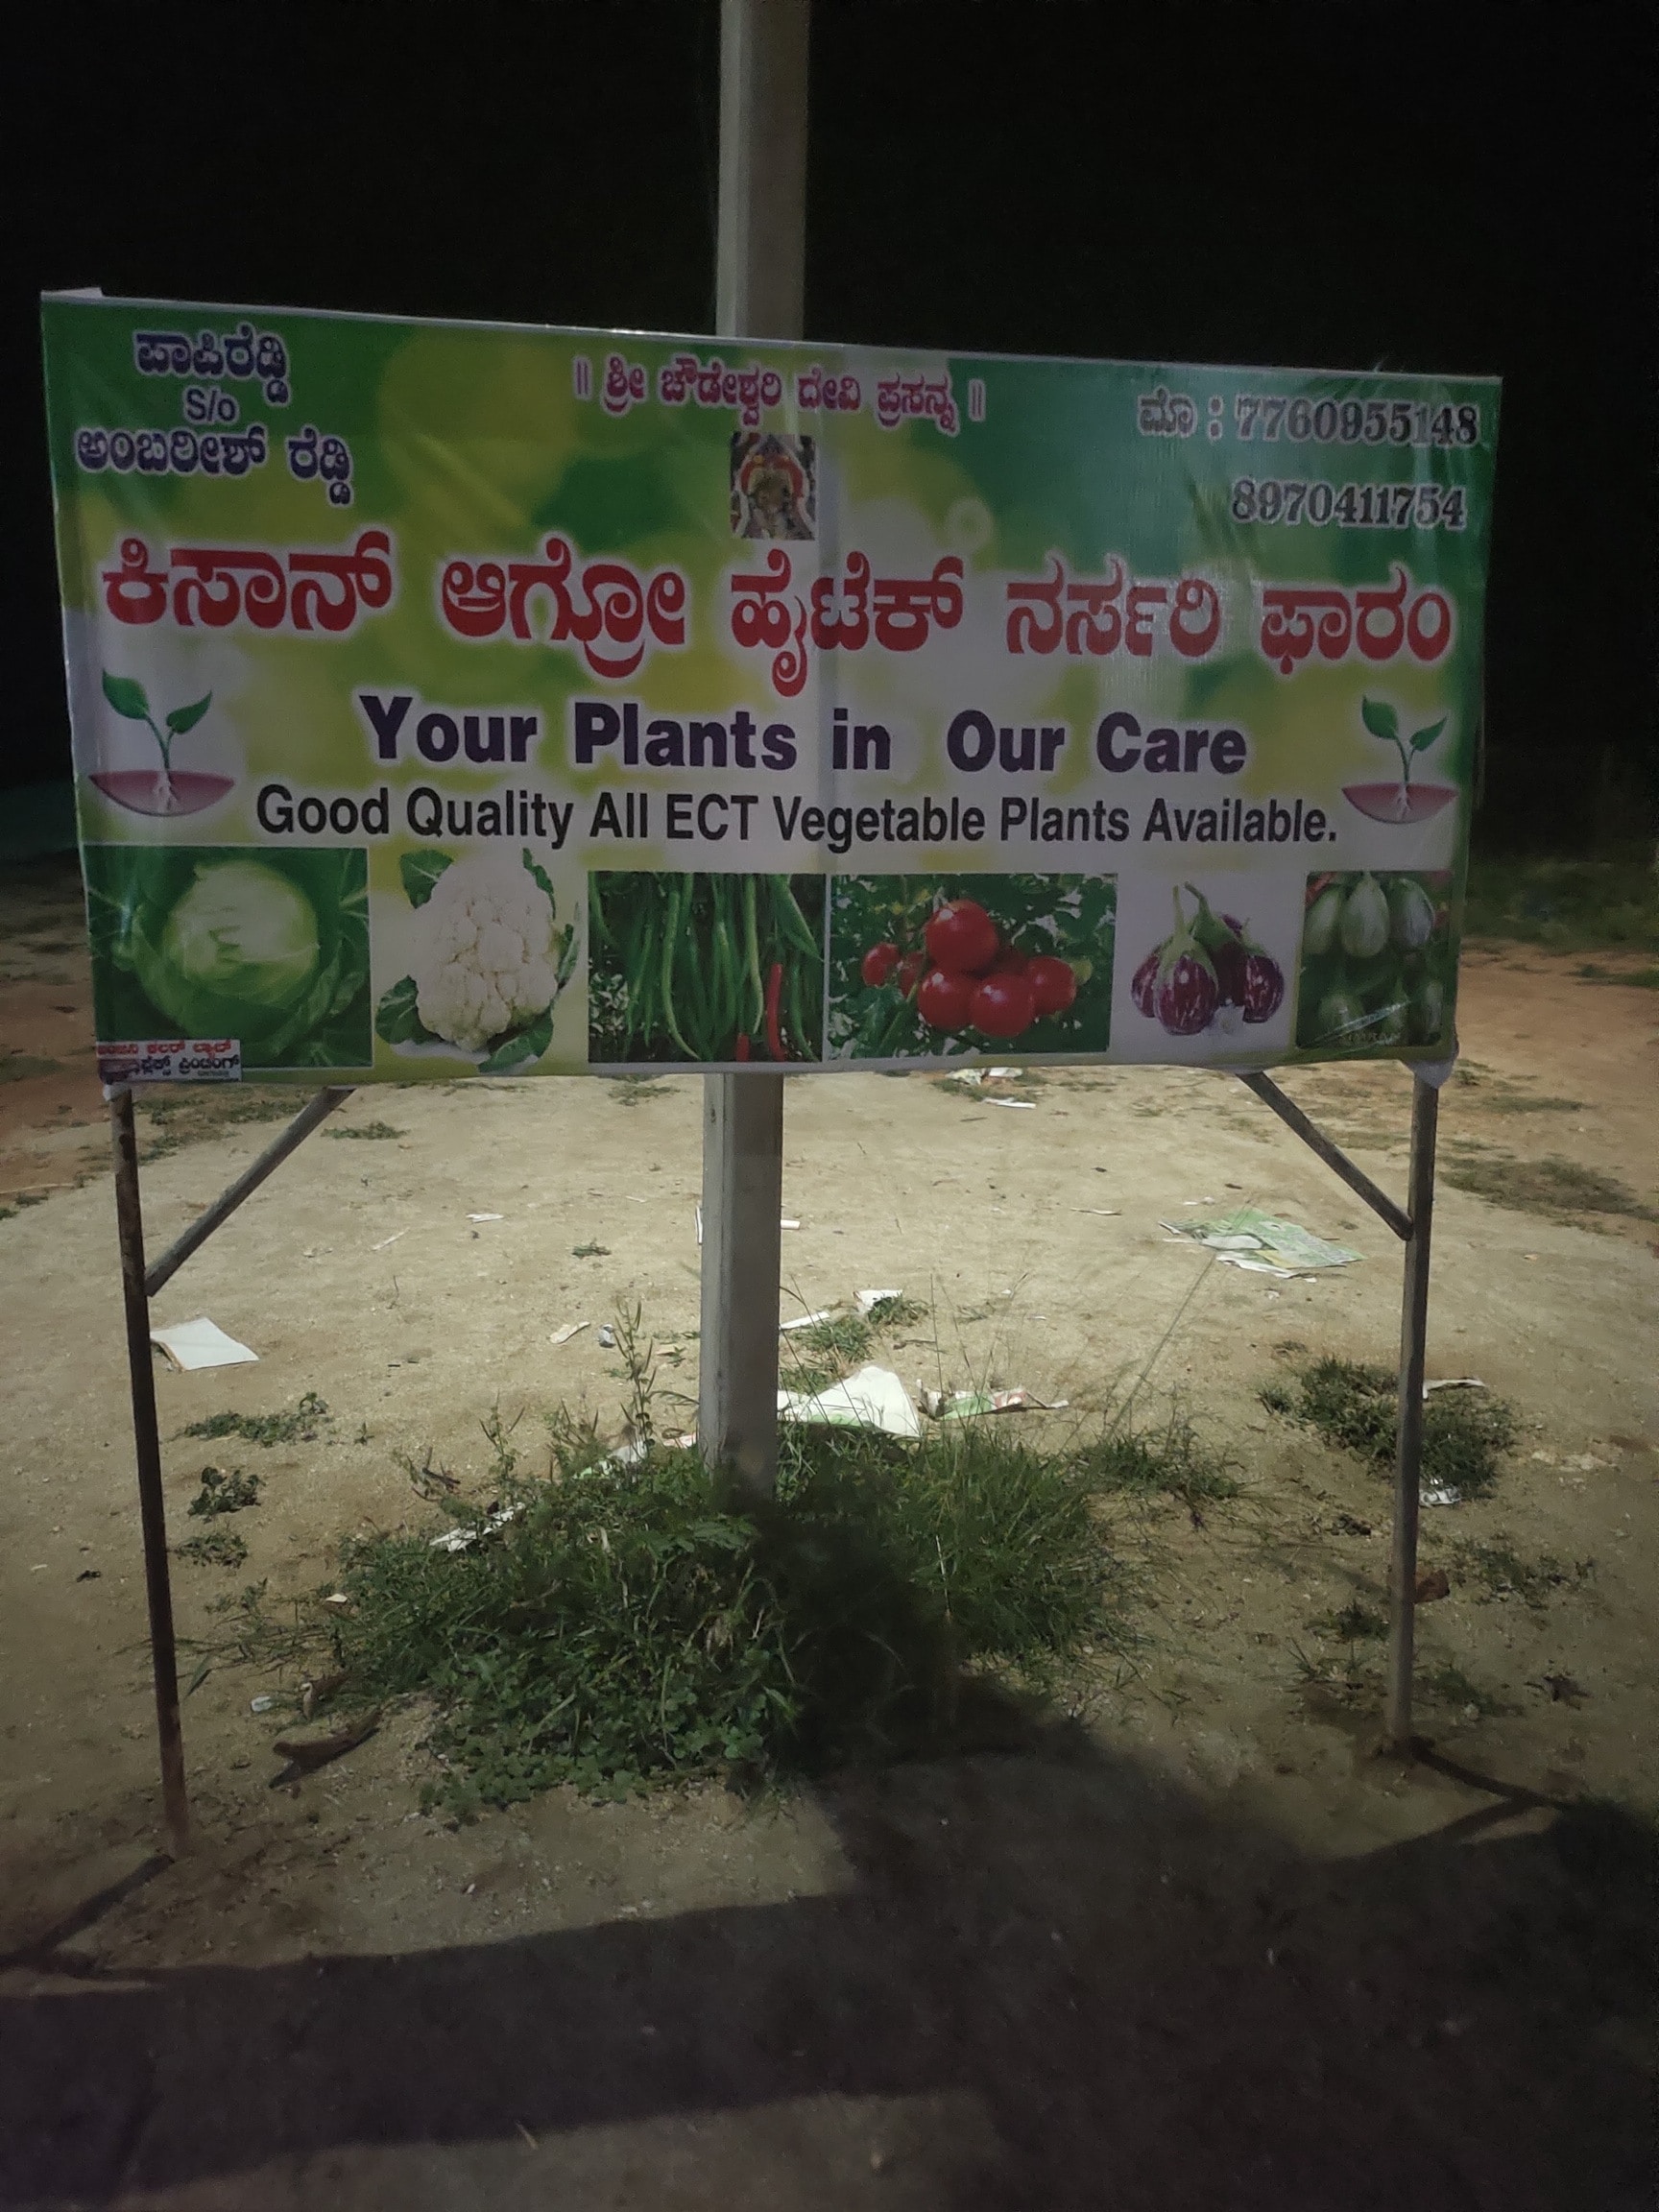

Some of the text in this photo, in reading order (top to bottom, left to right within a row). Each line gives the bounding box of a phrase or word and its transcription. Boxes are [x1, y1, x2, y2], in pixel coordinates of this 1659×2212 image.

[184, 388, 237, 422] S/o
[606, 356, 645, 413] ಶ್ರೀ
[661, 358, 782, 424] ಚೌಡೇಶ್ವರಿ
[798, 368, 861, 411] ದೇವಿ
[877, 373, 957, 431] ಪ್ರಸನ್ನ
[1236, 397, 1479, 445] 7760955148
[77, 425, 352, 506] ಅಂಬರೀಶ್ ರೆಡ್ಡಿ
[1233, 479, 1465, 527] 8970411754
[103, 530, 1452, 698] ಕಿಸಾನ್ ಆಗ್ರೋ ಹೈಟೆಕ್ ನರ್ಸರಿ ಫಾರಂ
[359, 694, 1247, 774] Your Plants in Our Care
[256, 783, 1337, 854] Good Quality All ECT Vegetable Plants Available.
